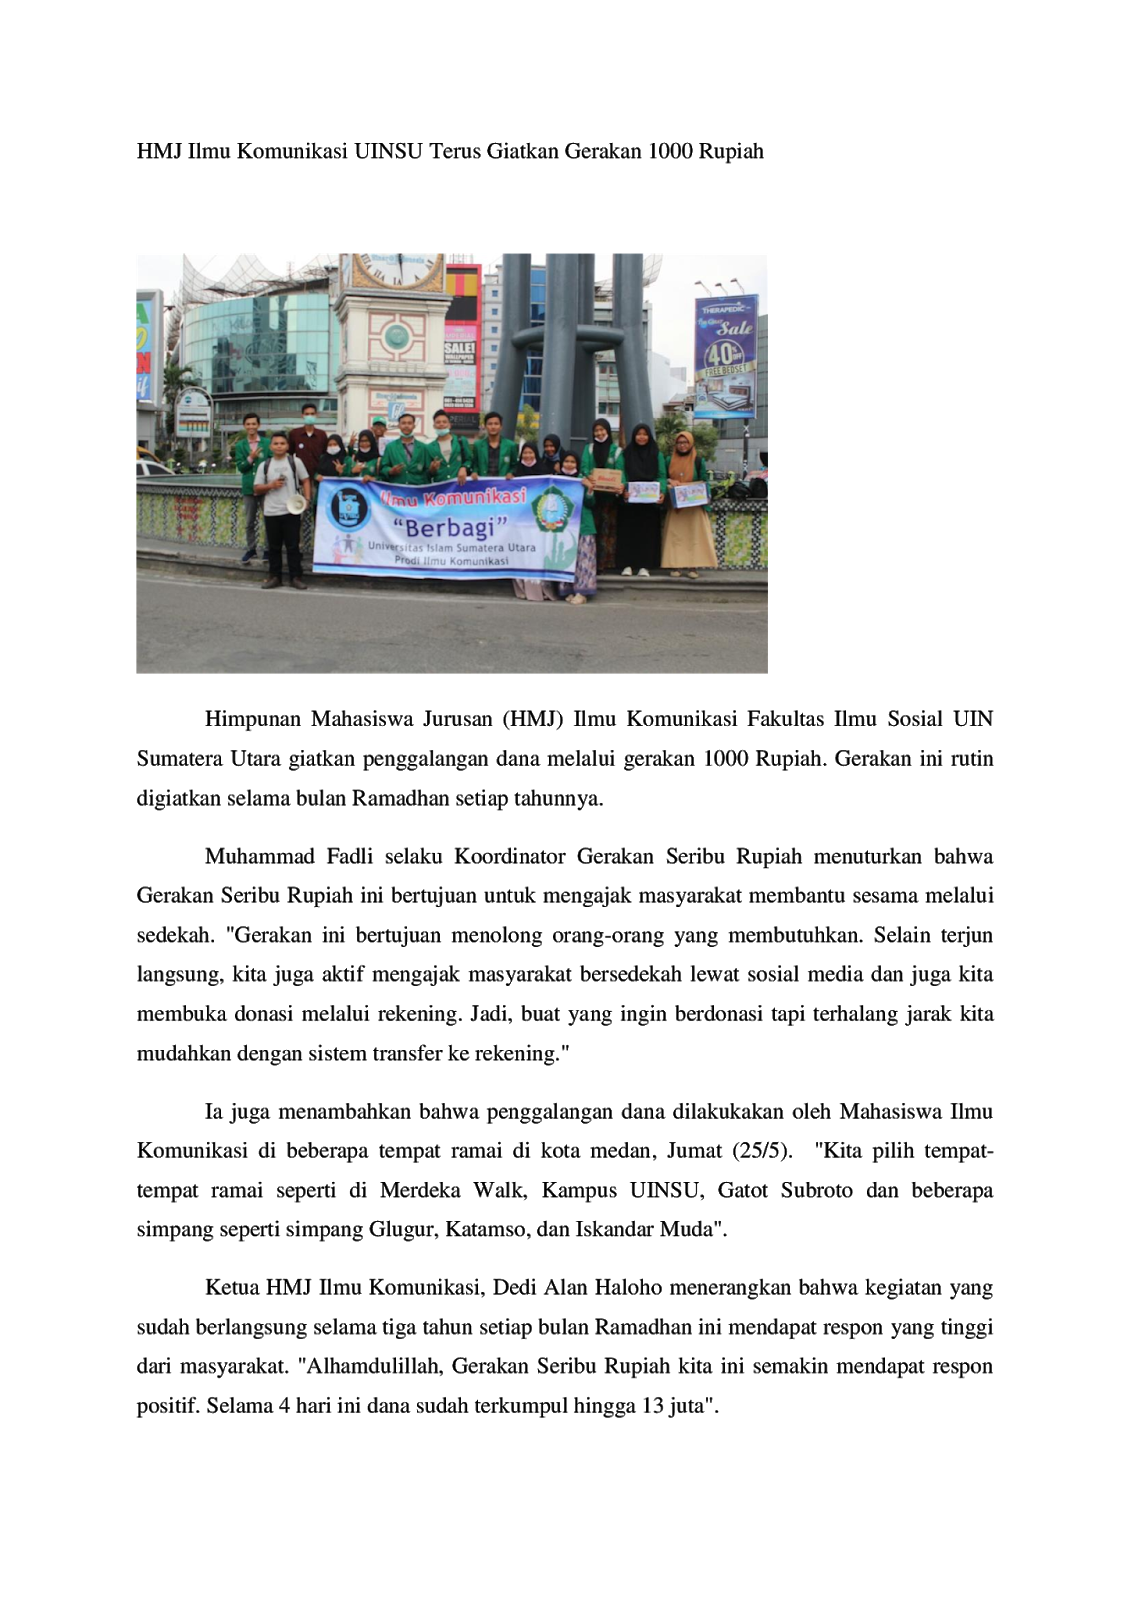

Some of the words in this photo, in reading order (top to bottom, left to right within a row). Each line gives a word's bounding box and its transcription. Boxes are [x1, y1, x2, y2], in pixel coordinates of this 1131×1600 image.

[702, 306, 745, 314] THERAPEDIC
[717, 321, 753, 335] Sale
[444, 342, 476, 354] SALE!
[732, 353, 742, 361] OFF
[705, 366, 721, 377] FREE
[722, 364, 747, 374] BEDSET
[380, 490, 418, 507] Ilmu
[424, 487, 526, 506] Komunikasi
[368, 541, 423, 552] Universitas
[427, 543, 453, 553] Islam
[456, 543, 504, 553] Sumatera
[508, 543, 536, 553] Utara
[394, 555, 420, 565] Prodi
[423, 556, 446, 566] Ilmu
[450, 556, 509, 566] Komunikasi
